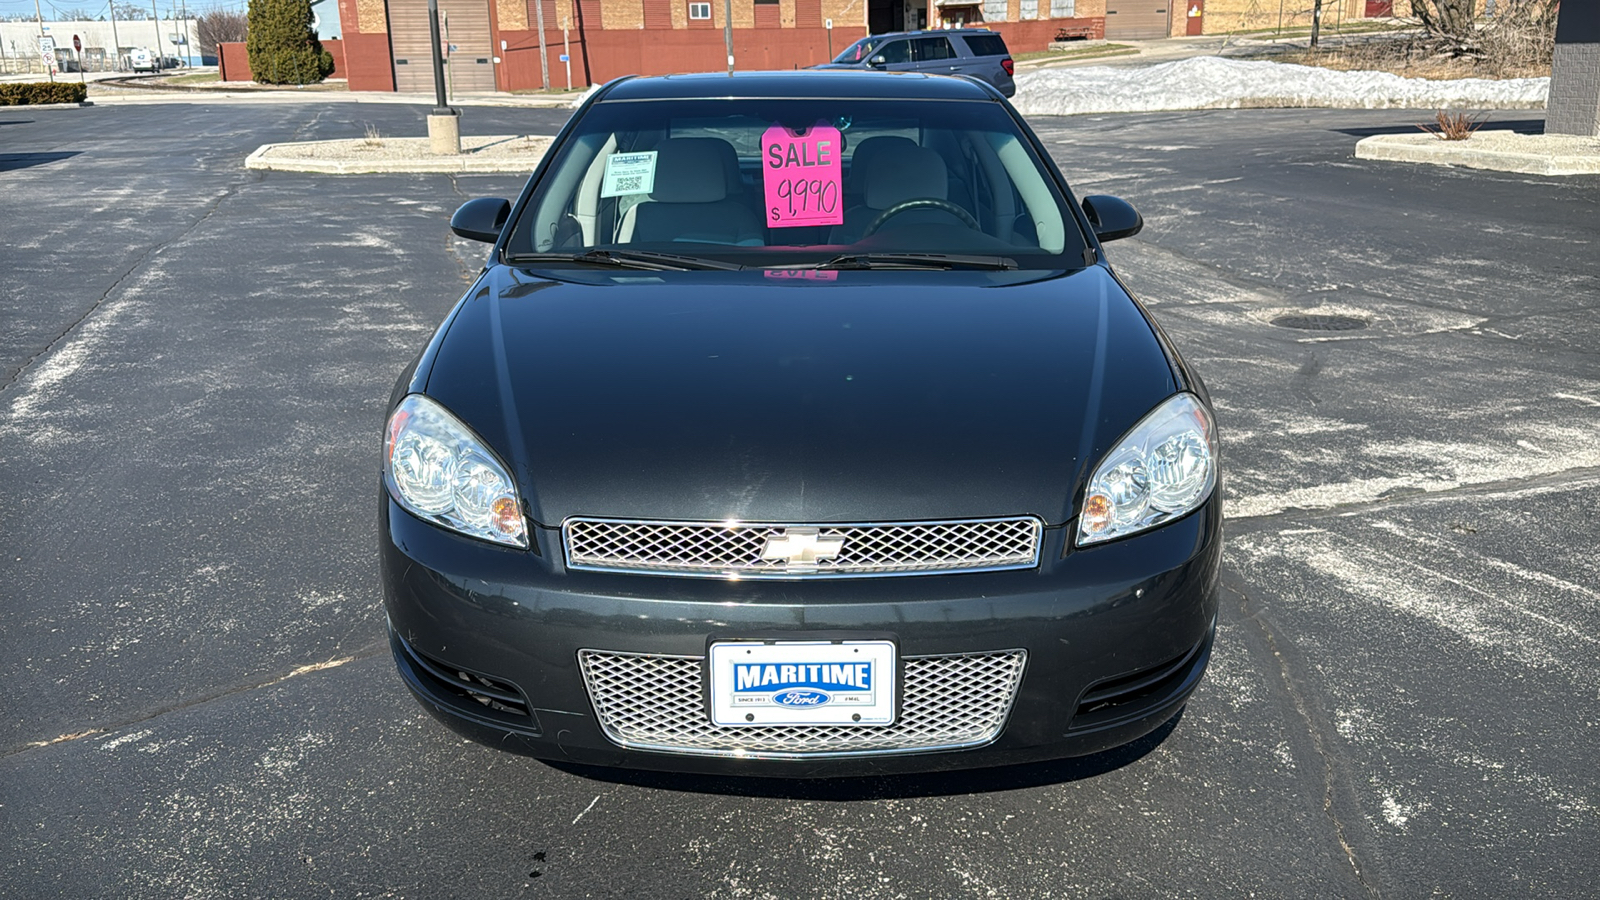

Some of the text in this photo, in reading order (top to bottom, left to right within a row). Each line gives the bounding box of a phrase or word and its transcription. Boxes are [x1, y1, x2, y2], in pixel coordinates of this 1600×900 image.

[768, 141, 832, 169] SALE
[737, 664, 869, 691] MARITIME
[783, 692, 820, 706] Ford
